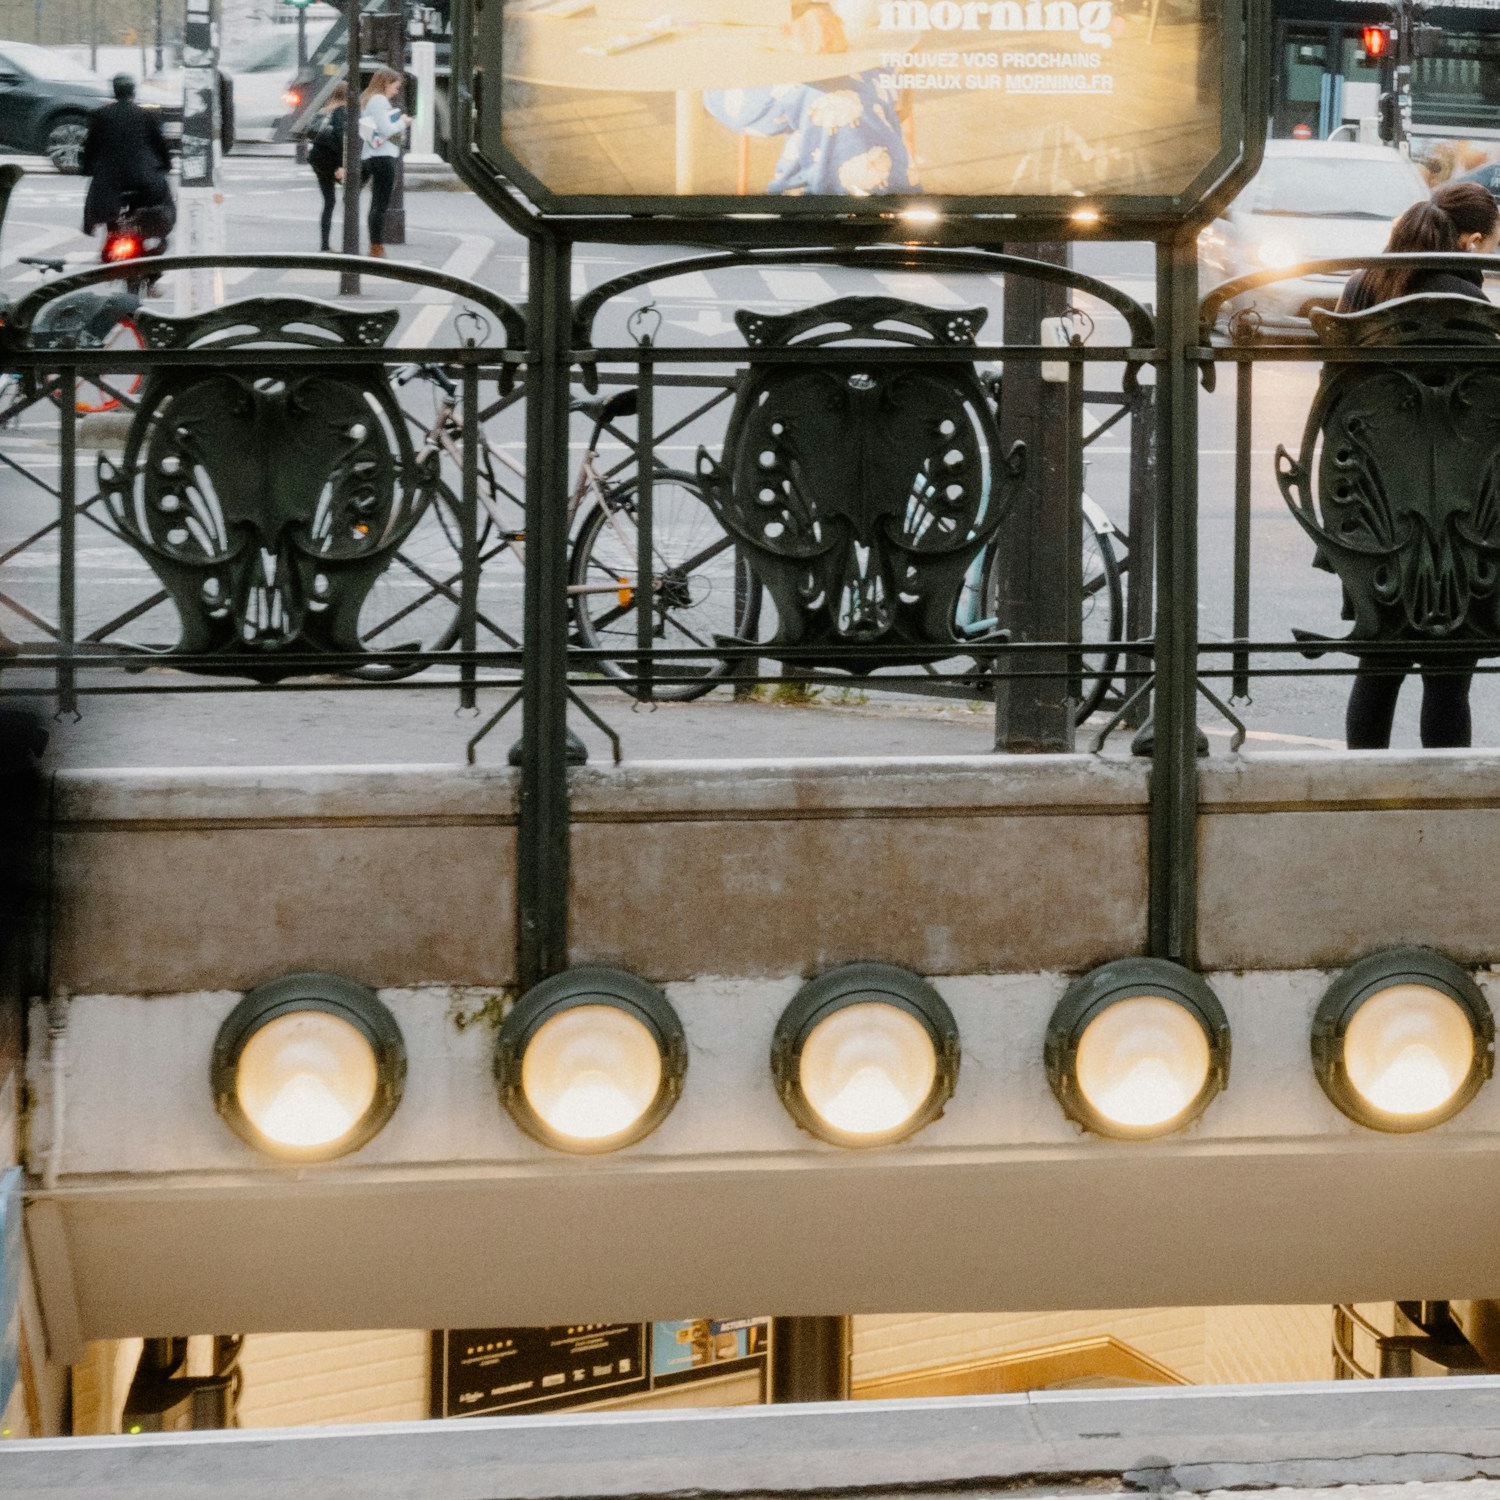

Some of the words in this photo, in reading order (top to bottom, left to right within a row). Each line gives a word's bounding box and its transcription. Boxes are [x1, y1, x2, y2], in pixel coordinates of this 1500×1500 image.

[880, 52, 959, 68] TROUVEZ
[961, 52, 999, 68] VOS
[1002, 52, 1101, 68] PROCHAINS
[879, 74, 962, 90] BUREAUX
[965, 74, 1002, 89] SUR
[1005, 74, 1114, 91] MORNING.FR
